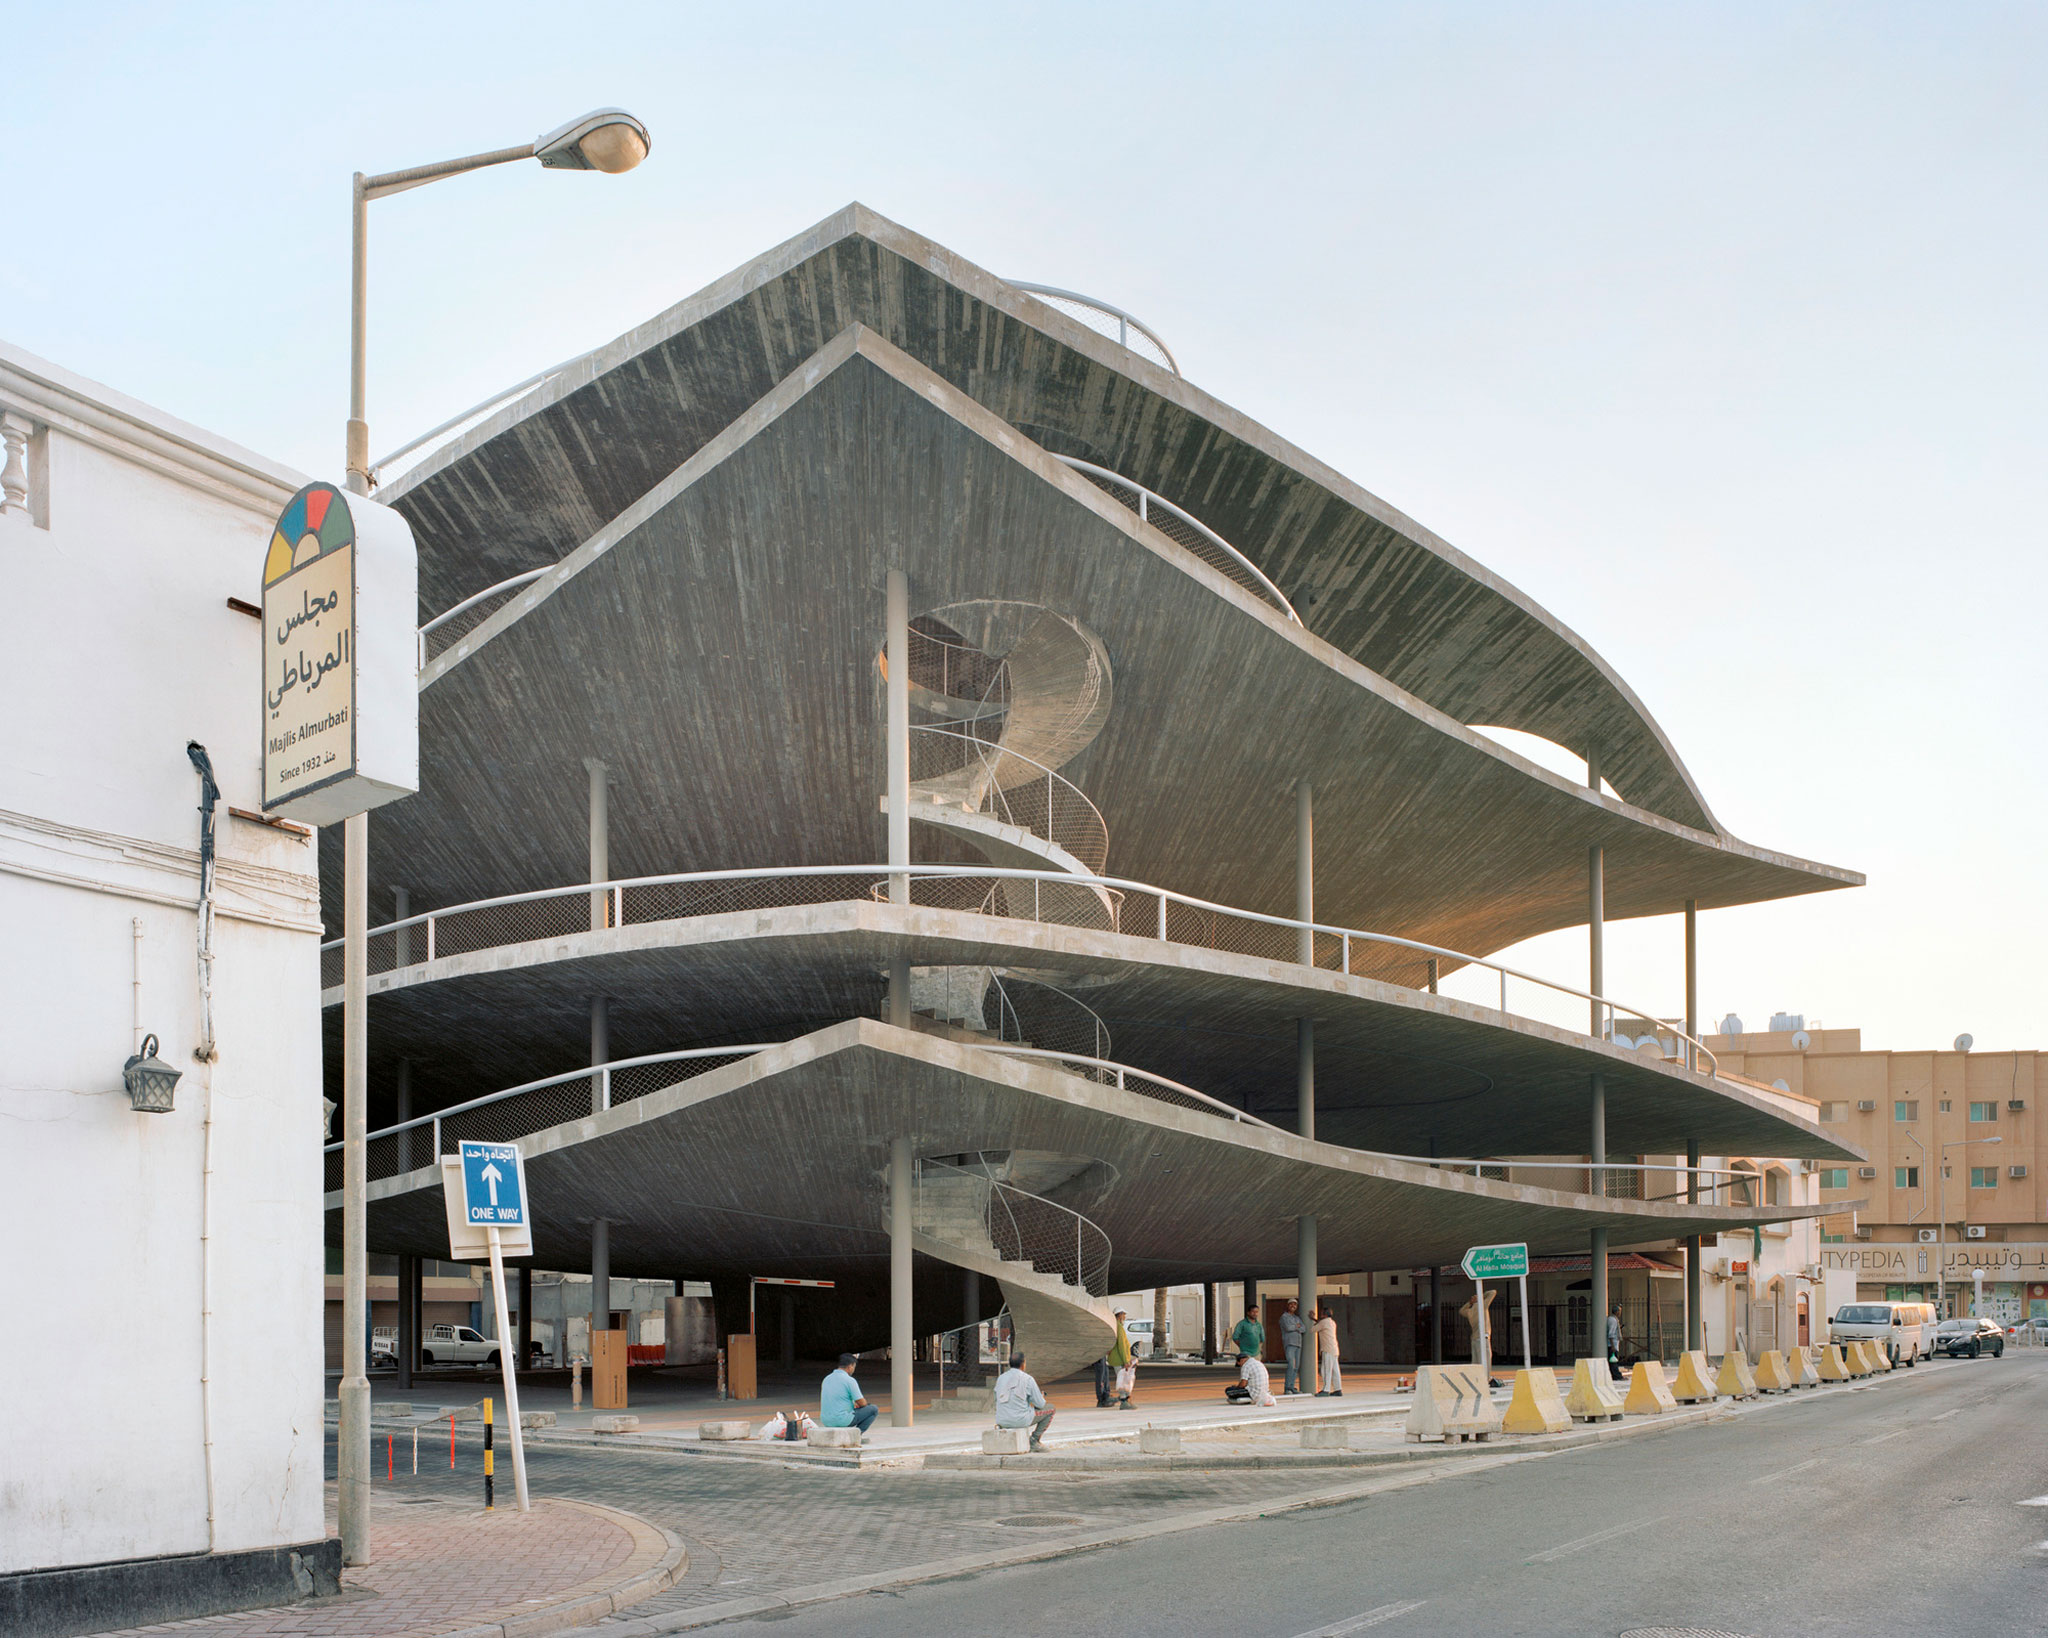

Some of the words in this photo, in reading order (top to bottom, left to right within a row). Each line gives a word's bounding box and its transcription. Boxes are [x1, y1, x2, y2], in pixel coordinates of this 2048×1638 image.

[277, 587, 338, 645] مجلس
[267, 629, 350, 720] المرباطي
[268, 728, 296, 755] Majlis
[298, 706, 349, 742] Almurbati
[280, 762, 300, 783] Since
[302, 755, 321, 774] 1932
[323, 751, 336, 766] منذ
[465, 1147, 490, 1161] واحد
[490, 1149, 514, 1163] اتجاه
[471, 1206, 495, 1219] ONE
[497, 1208, 520, 1220] WAY
[1500, 1263, 1525, 1271] Mosque
[1820, 1251, 1906, 1269] TYPEDIA
